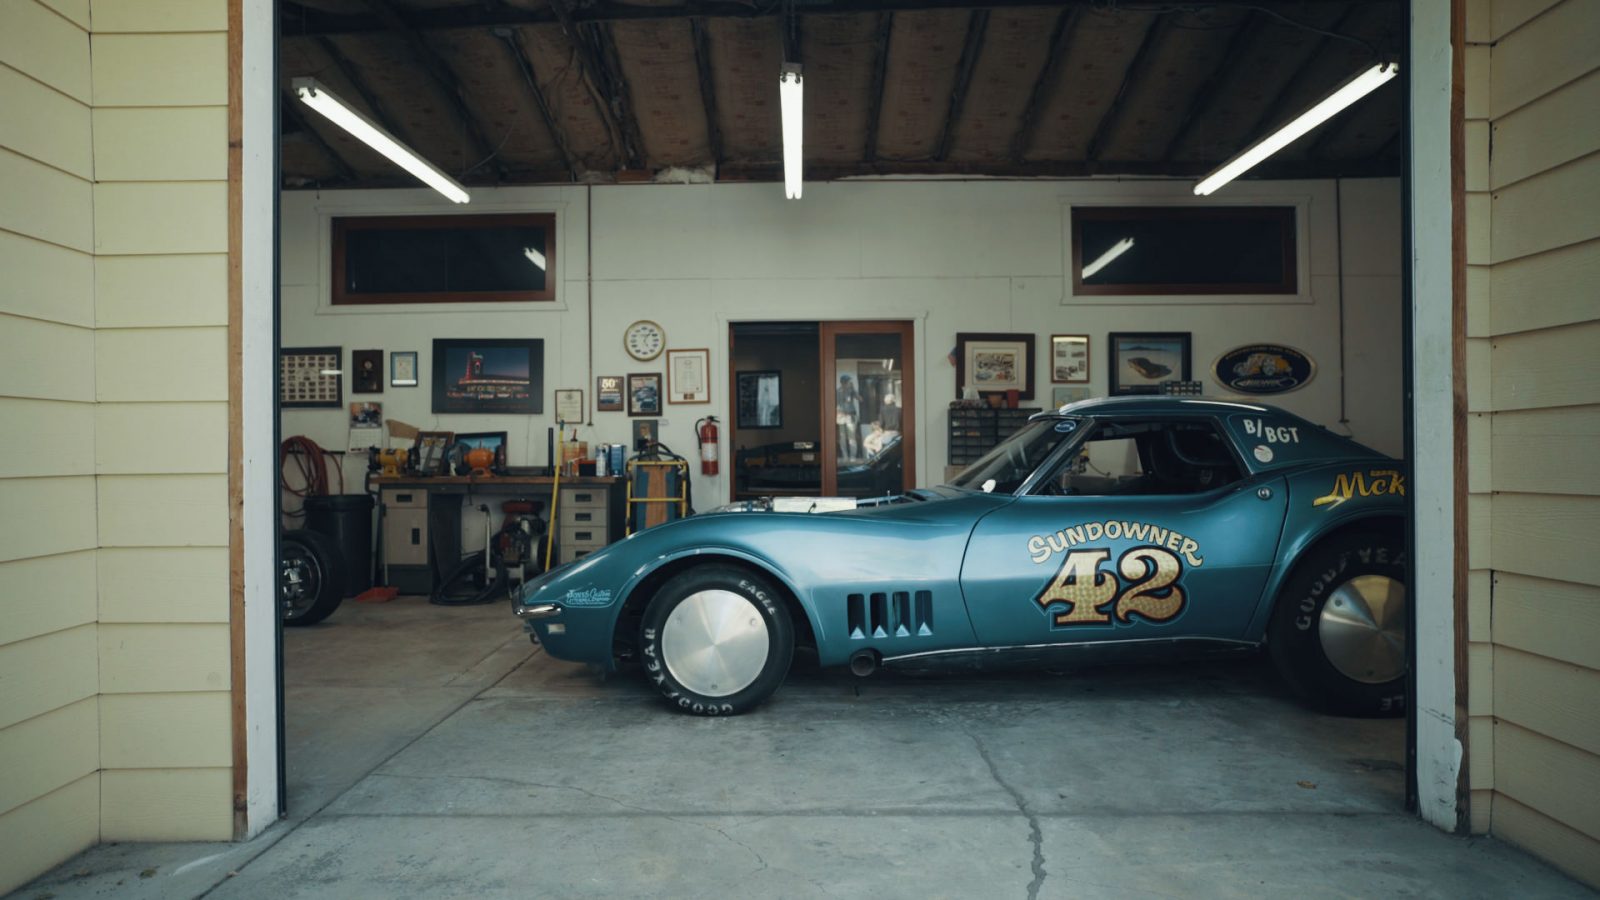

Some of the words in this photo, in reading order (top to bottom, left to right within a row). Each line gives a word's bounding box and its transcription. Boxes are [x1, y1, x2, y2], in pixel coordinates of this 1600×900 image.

[1243, 418, 1300, 443] B/BGT
[1027, 519, 1204, 568] SUNDOWNER
[738, 579, 777, 615] EAGLE
[1034, 545, 1184, 629] 42
[644, 628, 734, 716] GOODYEAR
